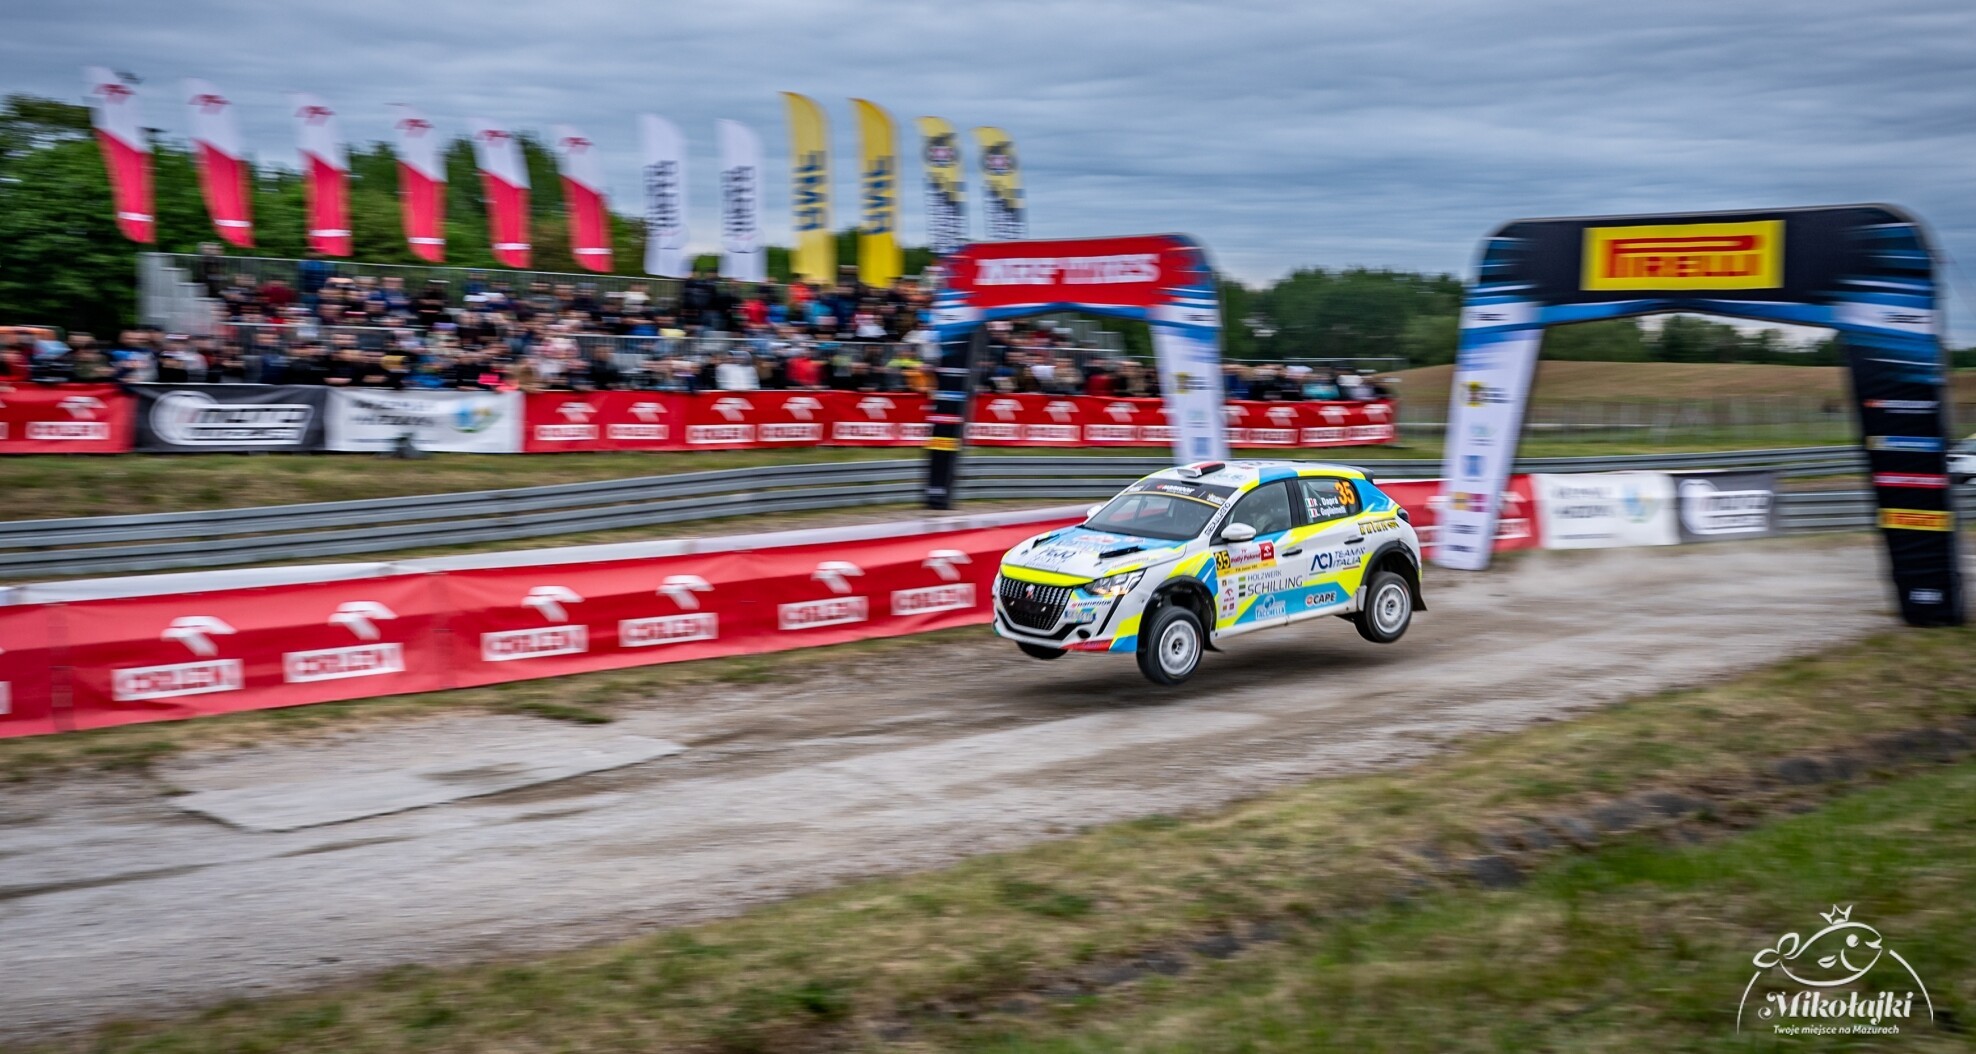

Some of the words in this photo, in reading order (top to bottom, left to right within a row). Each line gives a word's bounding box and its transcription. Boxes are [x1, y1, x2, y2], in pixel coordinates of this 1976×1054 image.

[1602, 235, 1766, 278] PIRELLI
[1334, 481, 1356, 506] 35
[1214, 551, 1231, 570] 35
[1311, 552, 1334, 571] ACI
[1333, 558, 1361, 569] ITALIA
[1247, 570, 1282, 581] HOLZWERK
[1247, 576, 1303, 598] SCHILLING
[1313, 592, 1336, 605] CAPE
